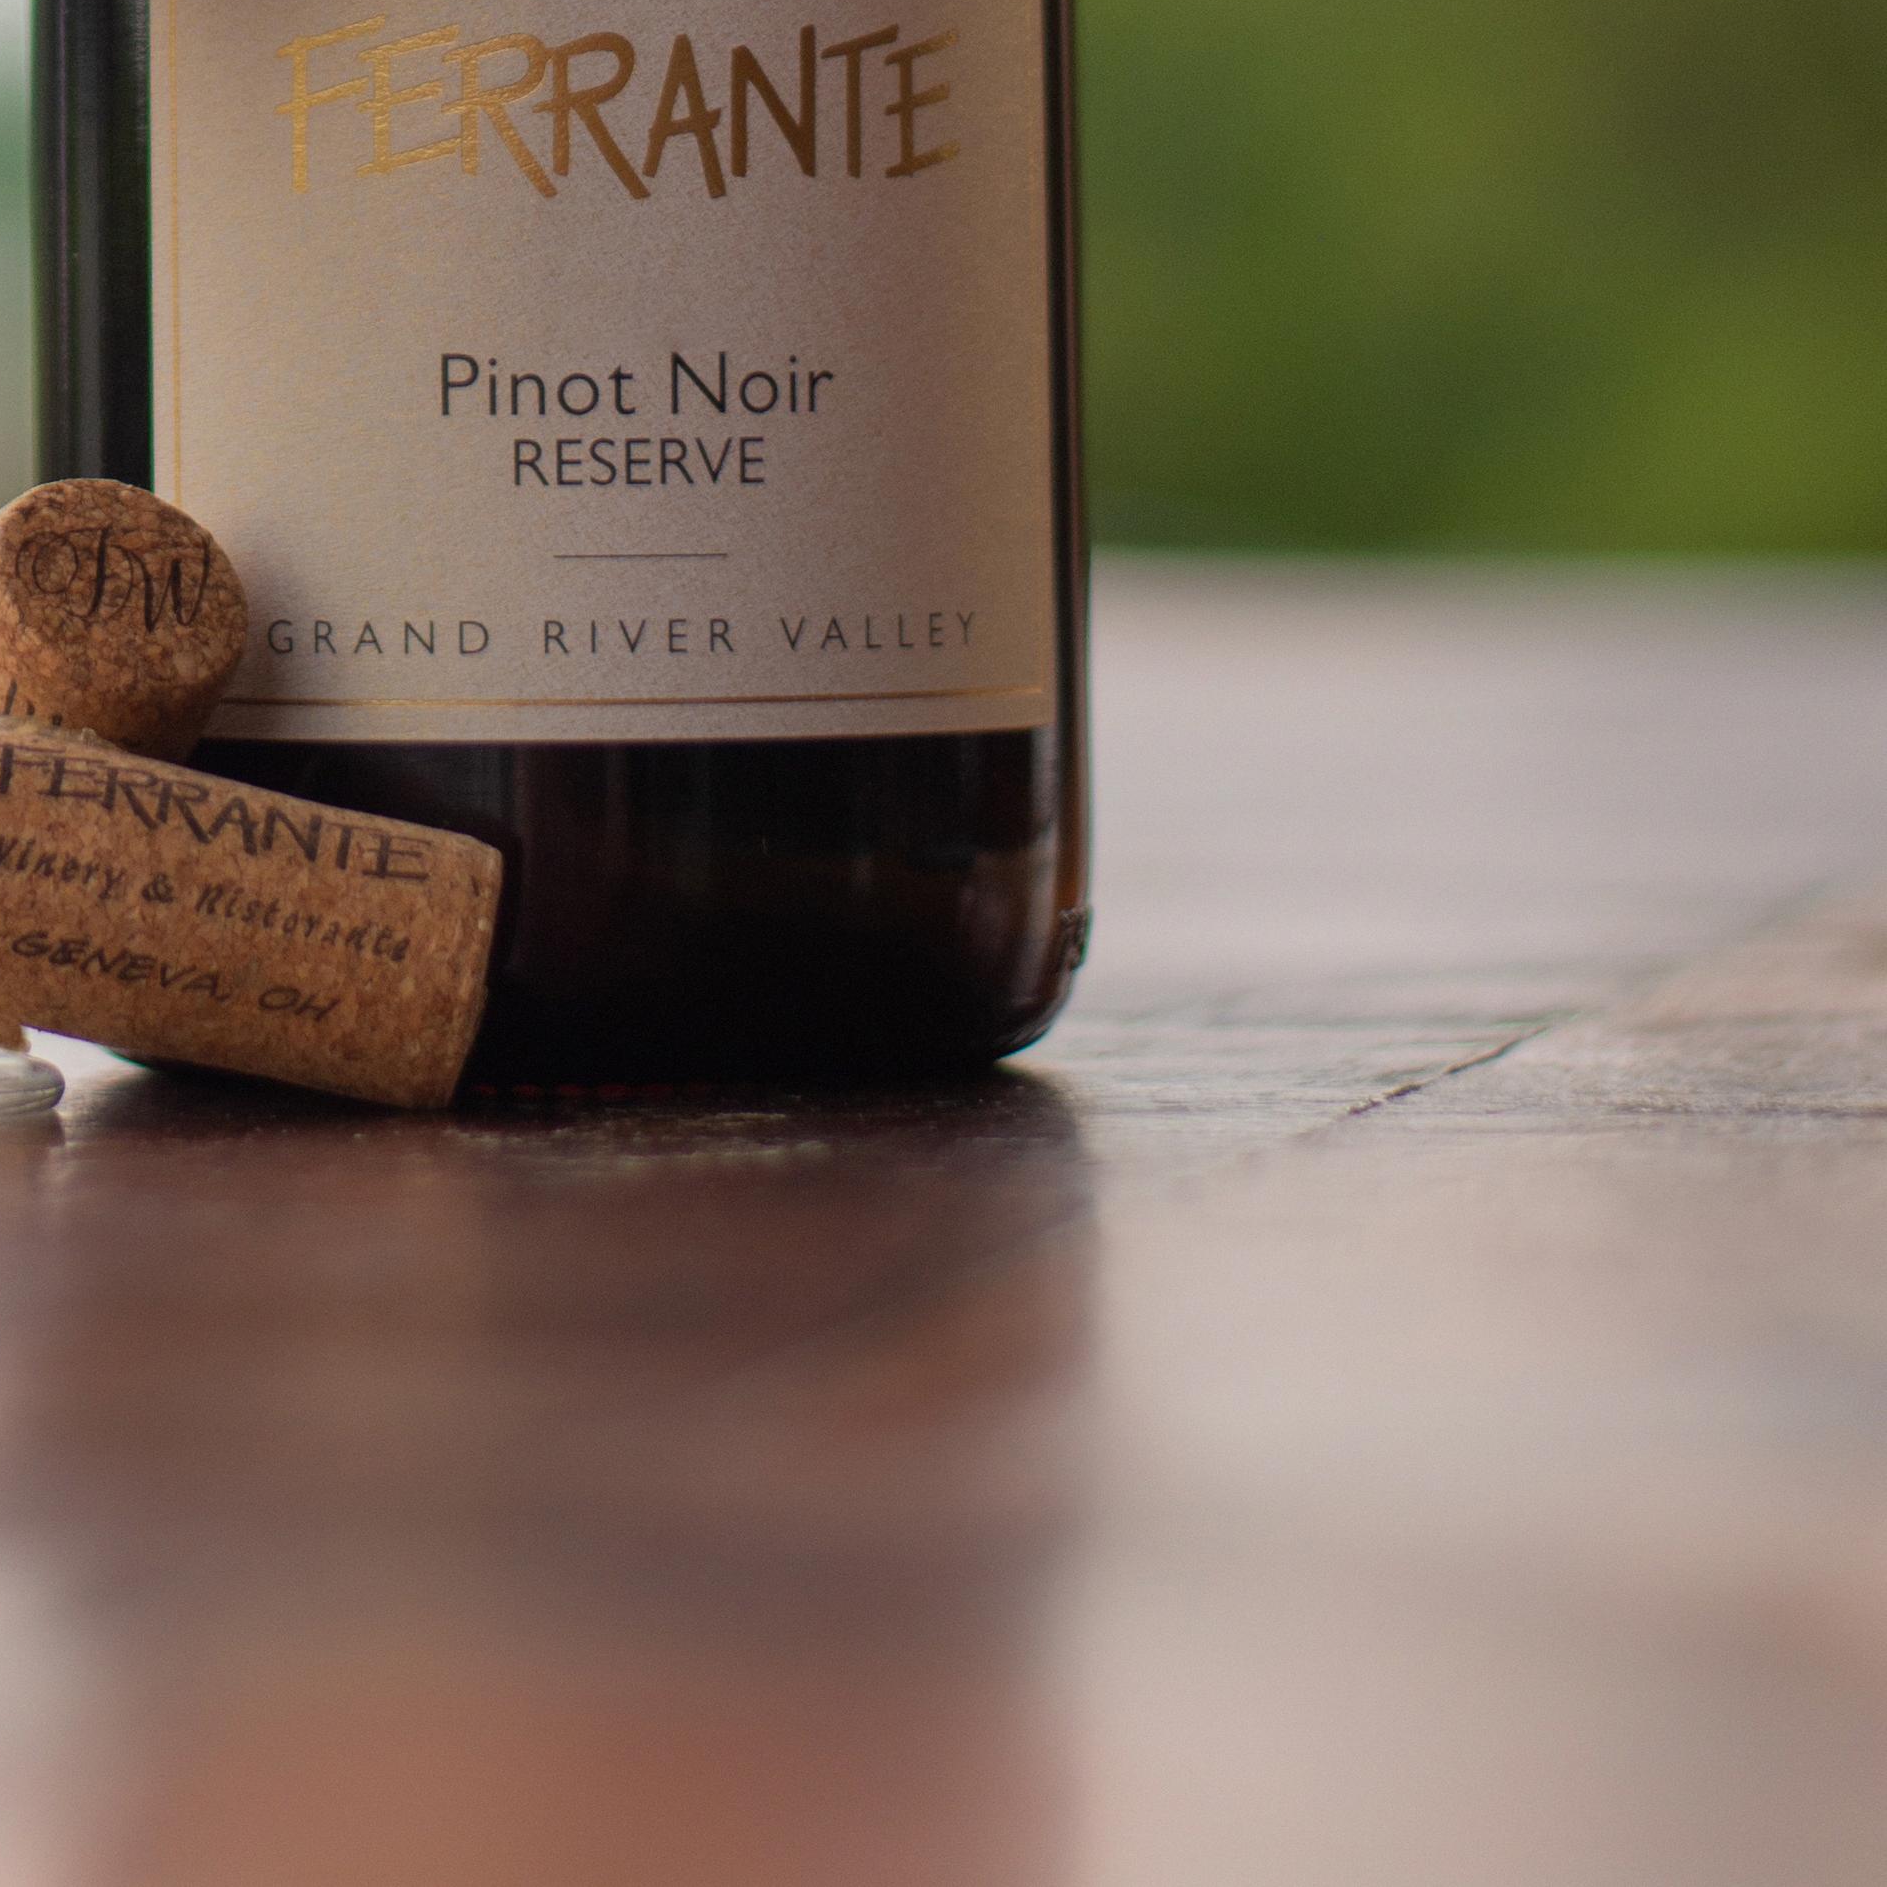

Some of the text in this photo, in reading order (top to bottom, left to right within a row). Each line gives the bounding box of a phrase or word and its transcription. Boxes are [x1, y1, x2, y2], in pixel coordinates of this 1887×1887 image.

[274, 13, 962, 200] FERRANTE
[439, 349, 835, 417] Pinot Noir
[513, 434, 767, 488] RESERVE
[266, 609, 977, 656] GRAND RIVER VALLEY
[141, 871, 174, 904] &
[257, 984, 342, 1024] OH
